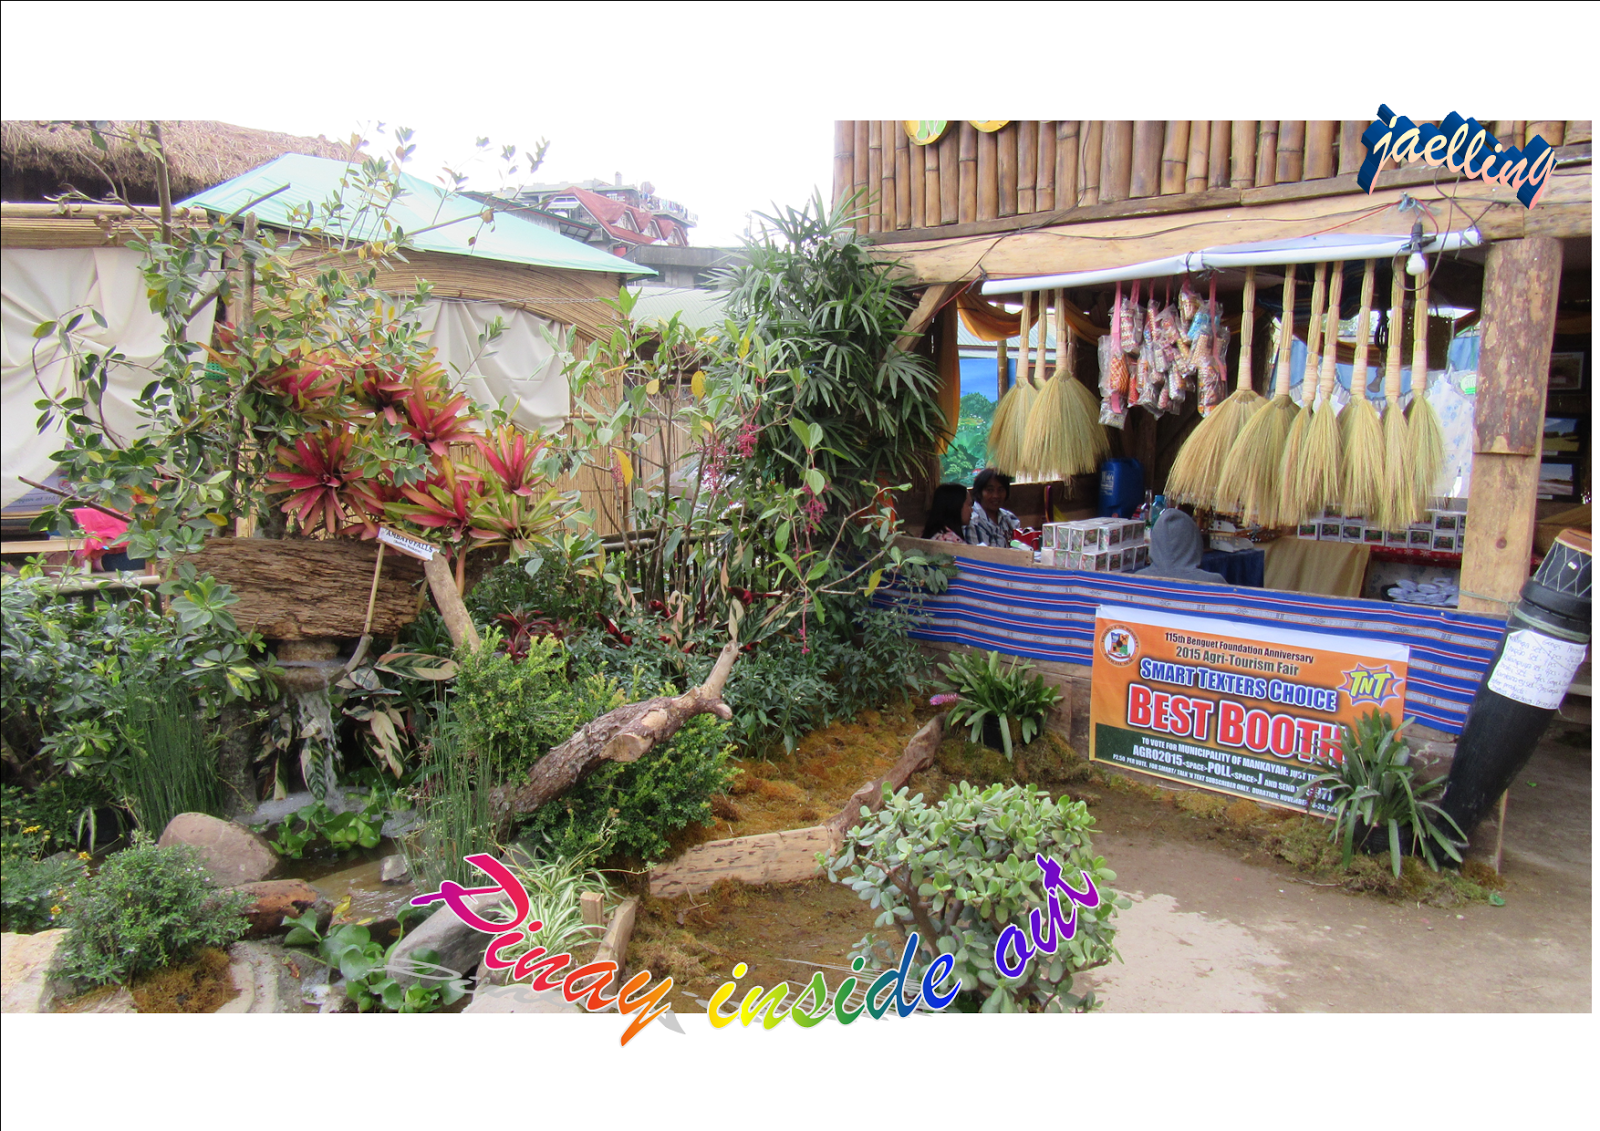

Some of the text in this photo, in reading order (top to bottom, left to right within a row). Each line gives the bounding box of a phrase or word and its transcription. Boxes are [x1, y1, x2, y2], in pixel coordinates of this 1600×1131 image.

[1165, 632, 1314, 664] 115th Benguet Foundation Anniversary
[1176, 646, 1299, 676] 2015 Agri-Tourism Fair
[1140, 657, 1338, 712] SMART TEXTERS CHOICE
[1128, 683, 1347, 769] BEST BOOTH
[1142, 737, 1150, 745] TO
[1150, 738, 1165, 749] VOTE
[1166, 742, 1178, 752] FOR
[1178, 743, 1231, 763] MUNICIPALITY
[1231, 755, 1242, 766] OF
[1264, 779, 1278, 789] AND
[1278, 782, 1296, 793] SEND
